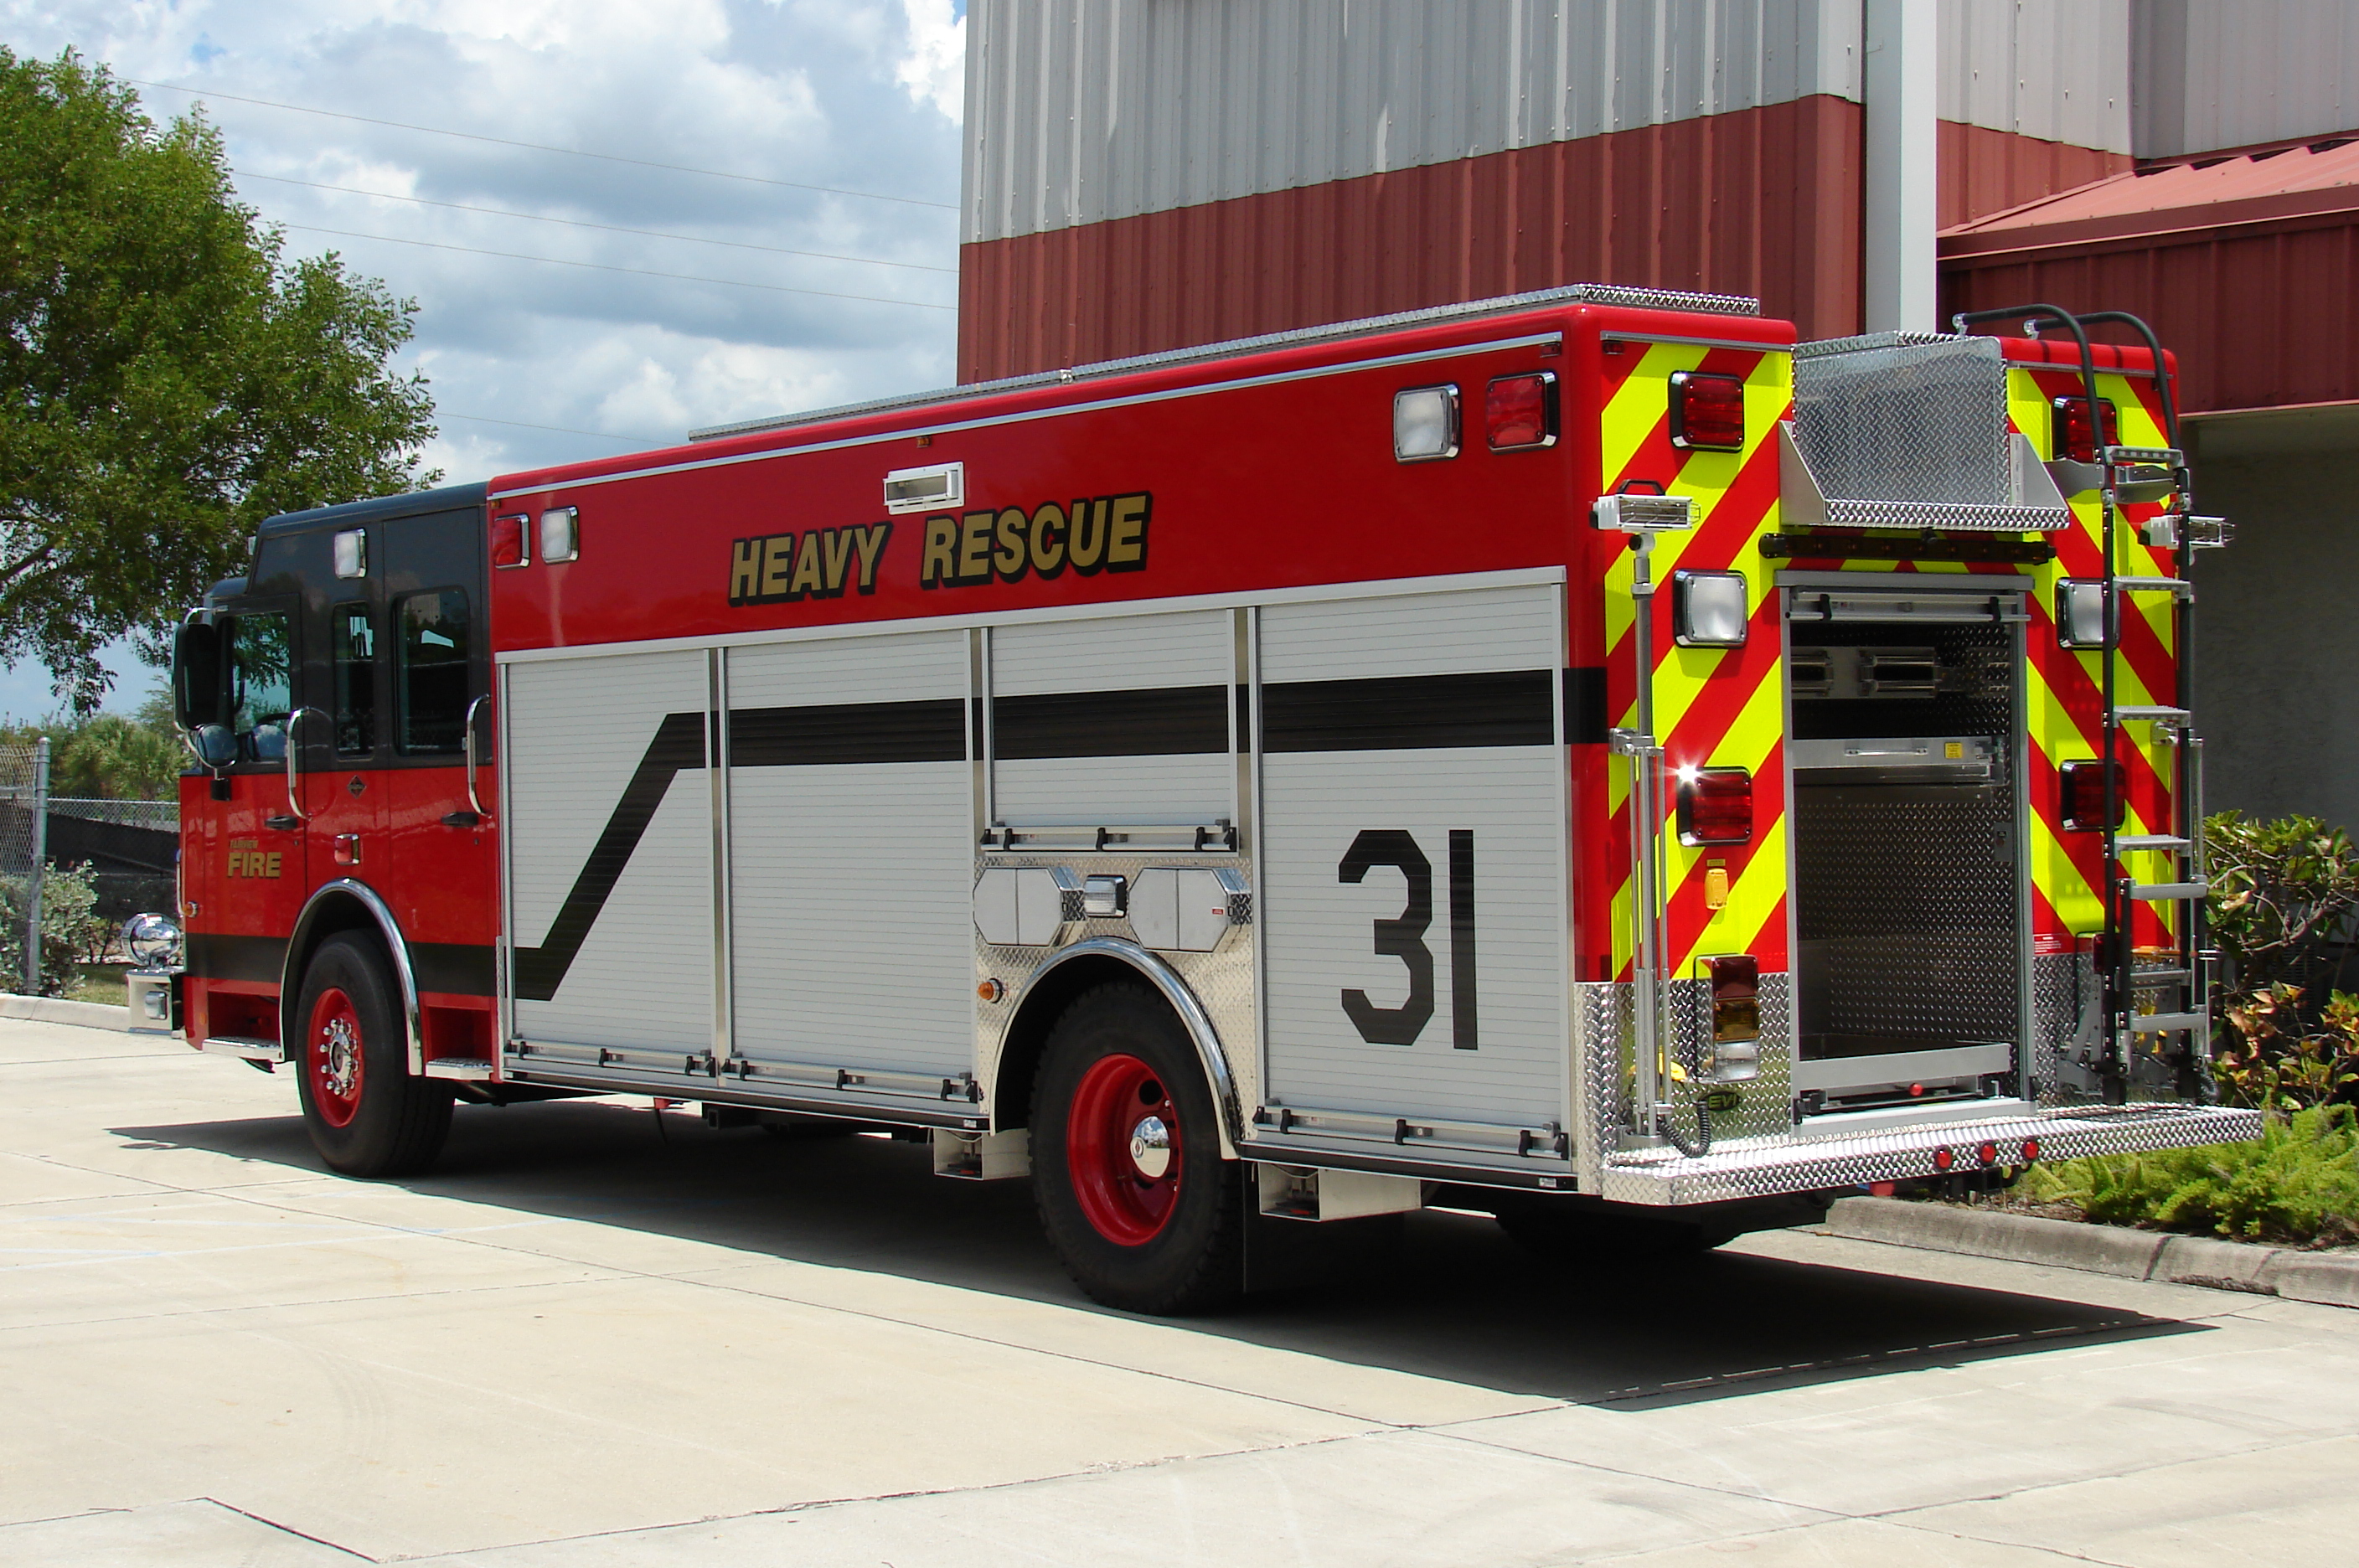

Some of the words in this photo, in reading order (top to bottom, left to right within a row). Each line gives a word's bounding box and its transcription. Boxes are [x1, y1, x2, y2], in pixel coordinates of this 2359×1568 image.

[729, 522, 893, 606] HEAVY
[921, 491, 1153, 590] RESCUE
[227, 852, 282, 879] FIRE
[1339, 829, 1478, 1050] 31
